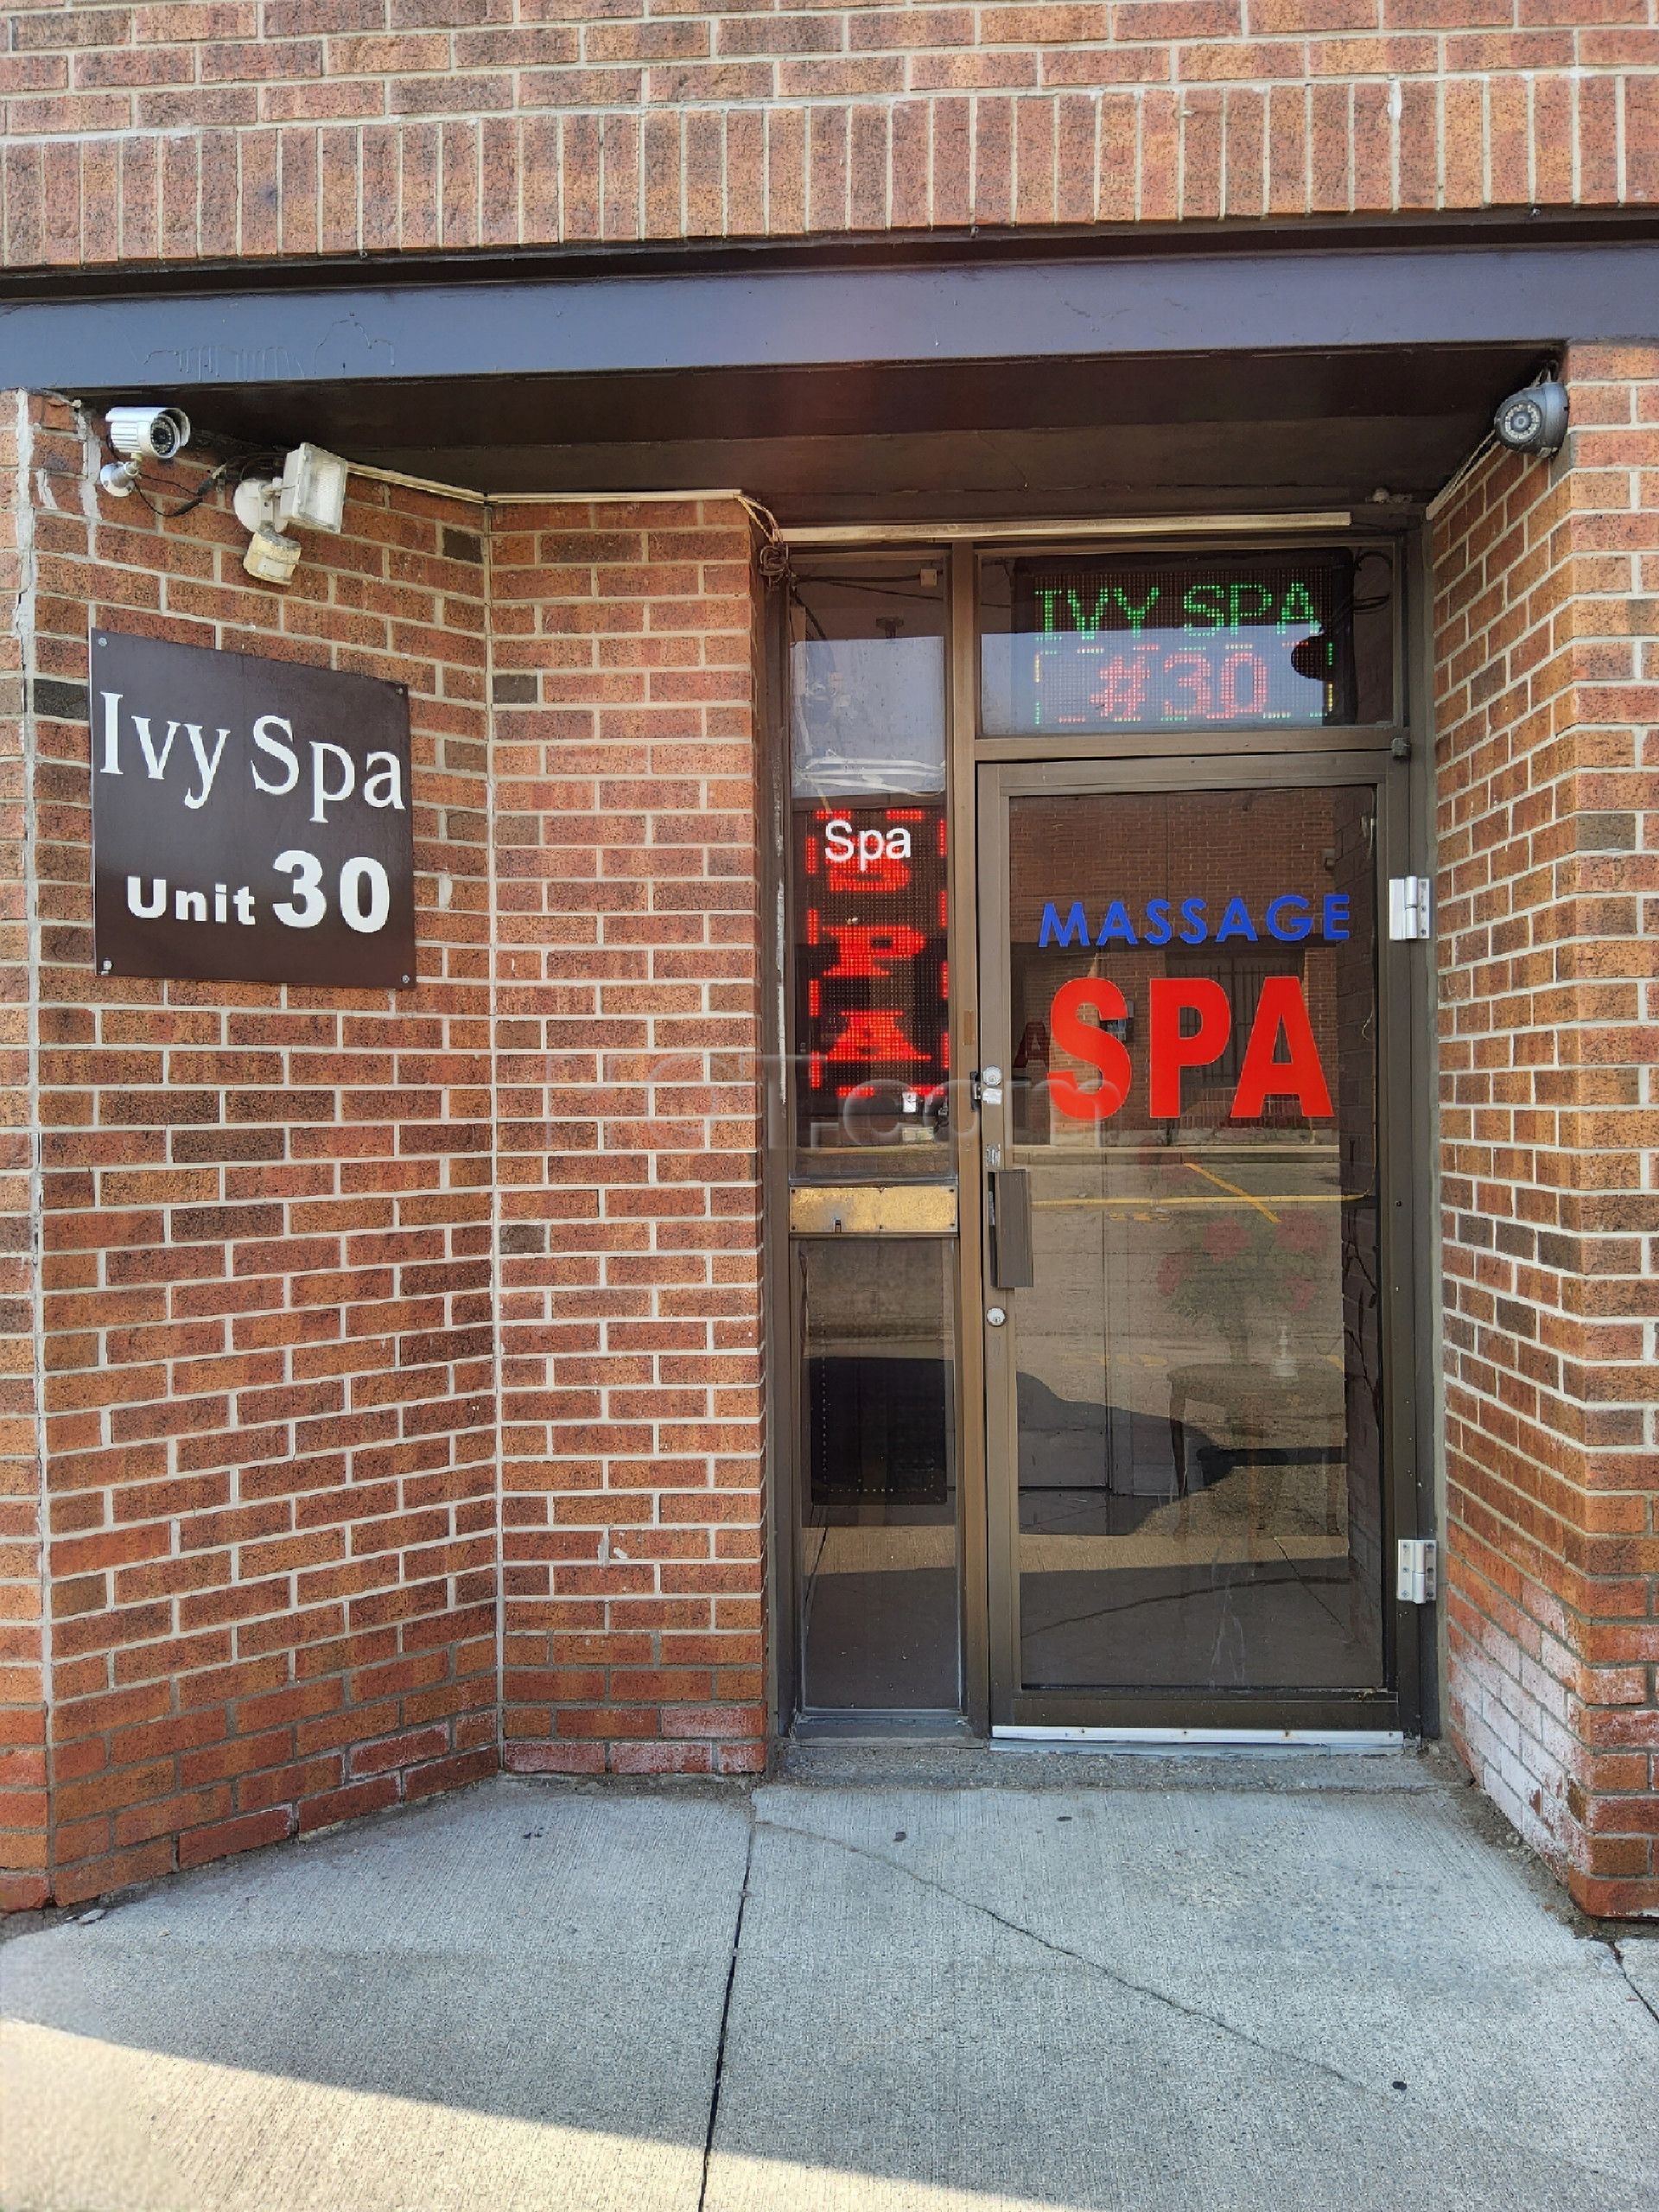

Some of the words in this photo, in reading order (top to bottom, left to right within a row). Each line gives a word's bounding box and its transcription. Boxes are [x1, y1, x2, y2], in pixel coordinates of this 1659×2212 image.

[1034, 586, 1160, 641] IVY
[1183, 581, 1324, 637] SPA
[1090, 652, 1268, 720] #30
[99, 691, 231, 810] Ivy
[250, 715, 405, 823] Spa
[824, 819, 912, 871] Spa
[126, 875, 257, 925] Unit
[271, 849, 391, 933] 30
[1038, 893, 1351, 948] MASSAGE
[1047, 976, 1335, 1122] SPA
